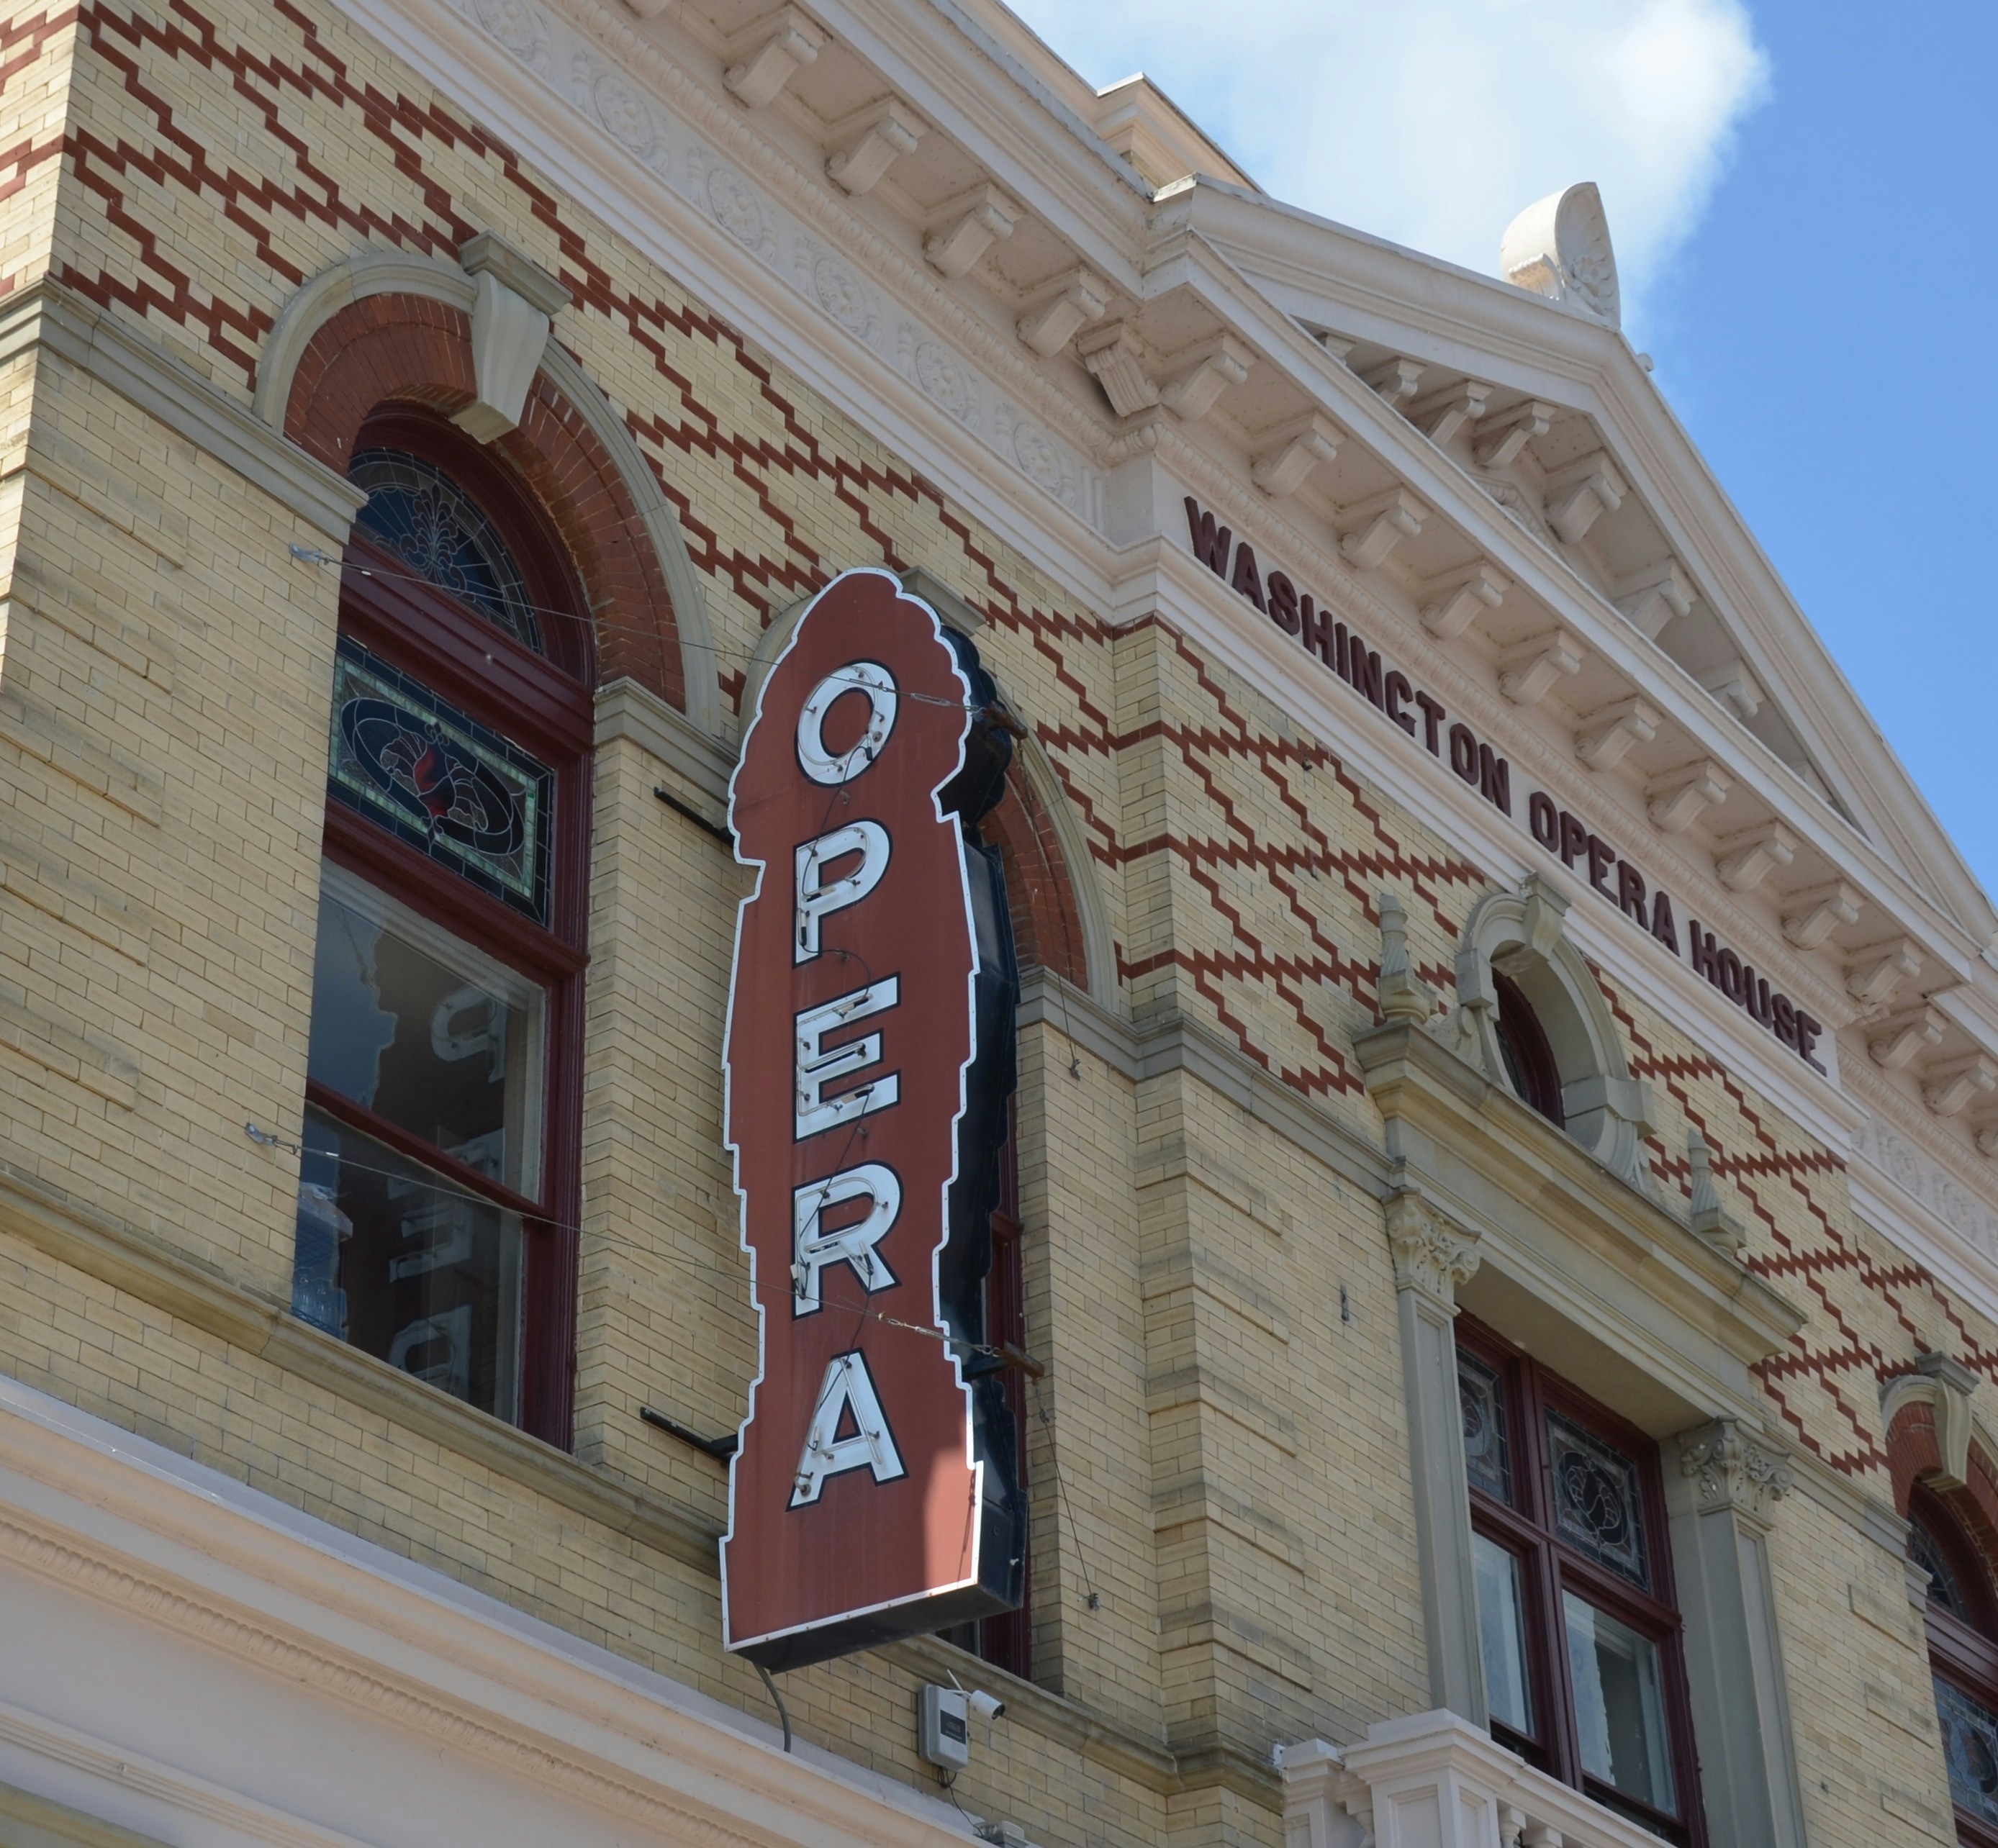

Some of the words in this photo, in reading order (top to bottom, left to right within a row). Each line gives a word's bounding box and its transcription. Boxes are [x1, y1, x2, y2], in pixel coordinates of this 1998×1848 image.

[787, 659, 908, 1511] OPERA
[1183, 496, 1511, 818] WASHINGTON
[1529, 791, 1681, 958] OPERA
[1689, 919, 1827, 1078] HOUSE
